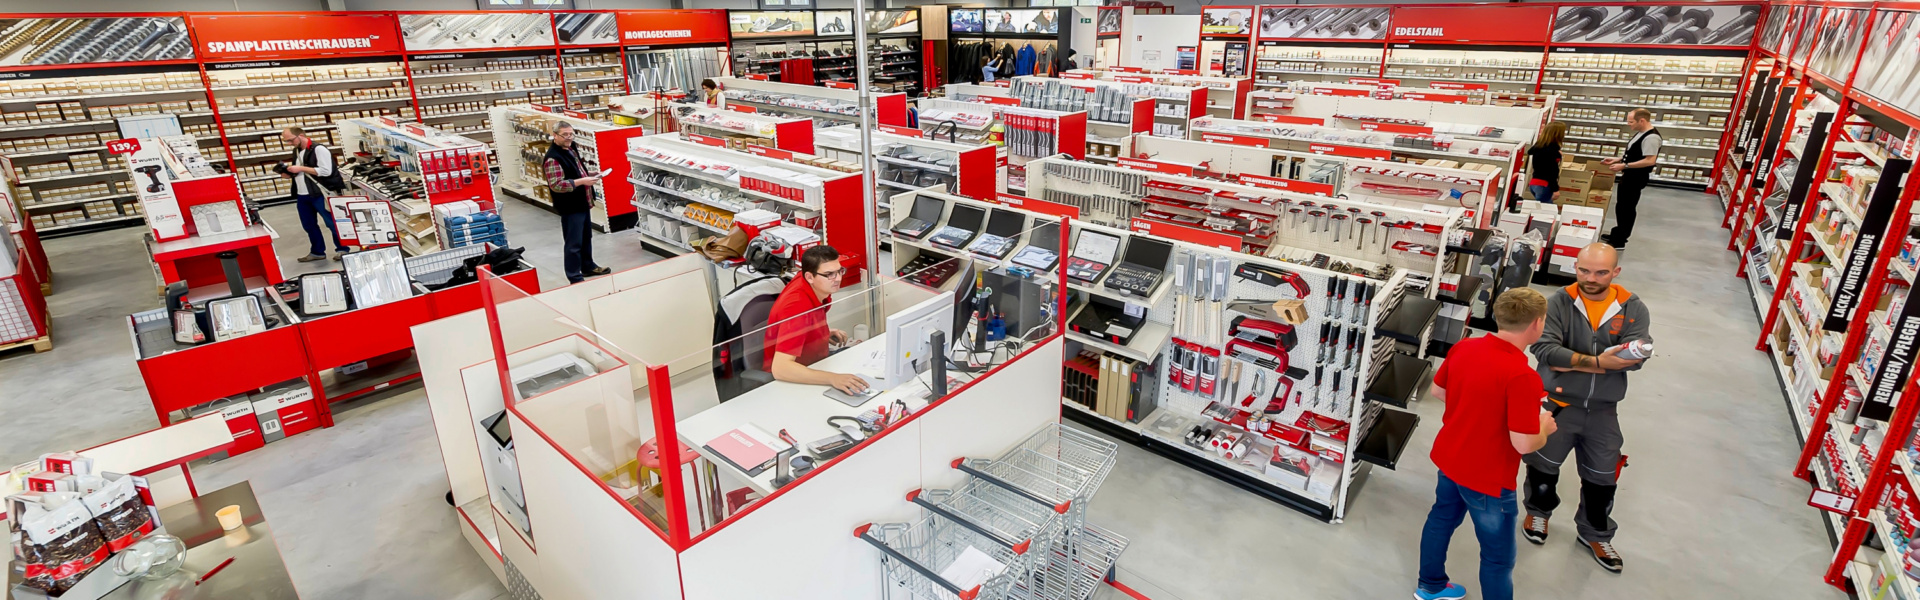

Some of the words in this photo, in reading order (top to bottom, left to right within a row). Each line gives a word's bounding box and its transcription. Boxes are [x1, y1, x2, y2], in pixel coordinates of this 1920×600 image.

[625, 30, 691, 39] MONTAGESCHIENEN
[1395, 27, 1444, 36] EDELSTAHL
[207, 38, 371, 53] SPANPLATTENSCHRAUBEN
[1240, 175, 1288, 187] SCHRAUBWERKZEUG
[1782, 203, 1798, 230] SILIKONE
[1133, 220, 1151, 230] SÄGEN
[1832, 233, 1876, 318] LACKE/UNTERGRÜNDE
[1873, 315, 1920, 404] REINIGEN/PFLEGEN
